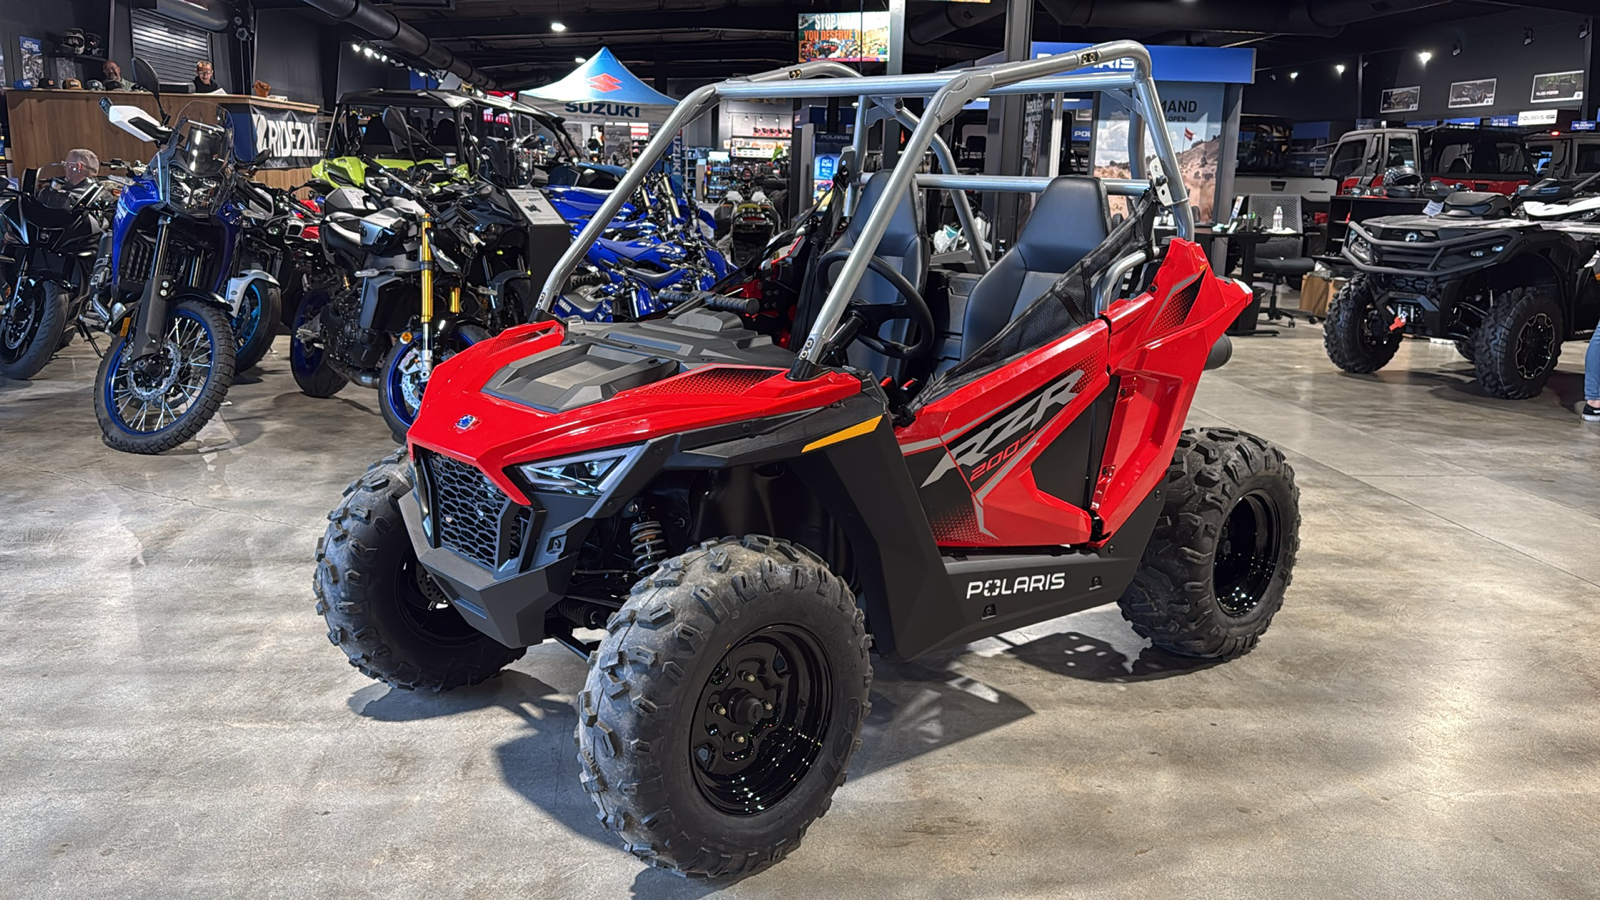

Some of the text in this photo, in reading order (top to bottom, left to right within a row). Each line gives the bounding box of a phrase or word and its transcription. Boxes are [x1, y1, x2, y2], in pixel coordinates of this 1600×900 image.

[804, 30, 819, 40] YOU
[821, 29, 853, 40] DESERVE
[814, 14, 838, 30] STOP
[565, 102, 641, 118] SUZUKI
[672, 134, 682, 175] UZUKI
[920, 369, 1085, 489] RZR
[970, 440, 1020, 483] 200
[966, 573, 1066, 600] POLARIS
